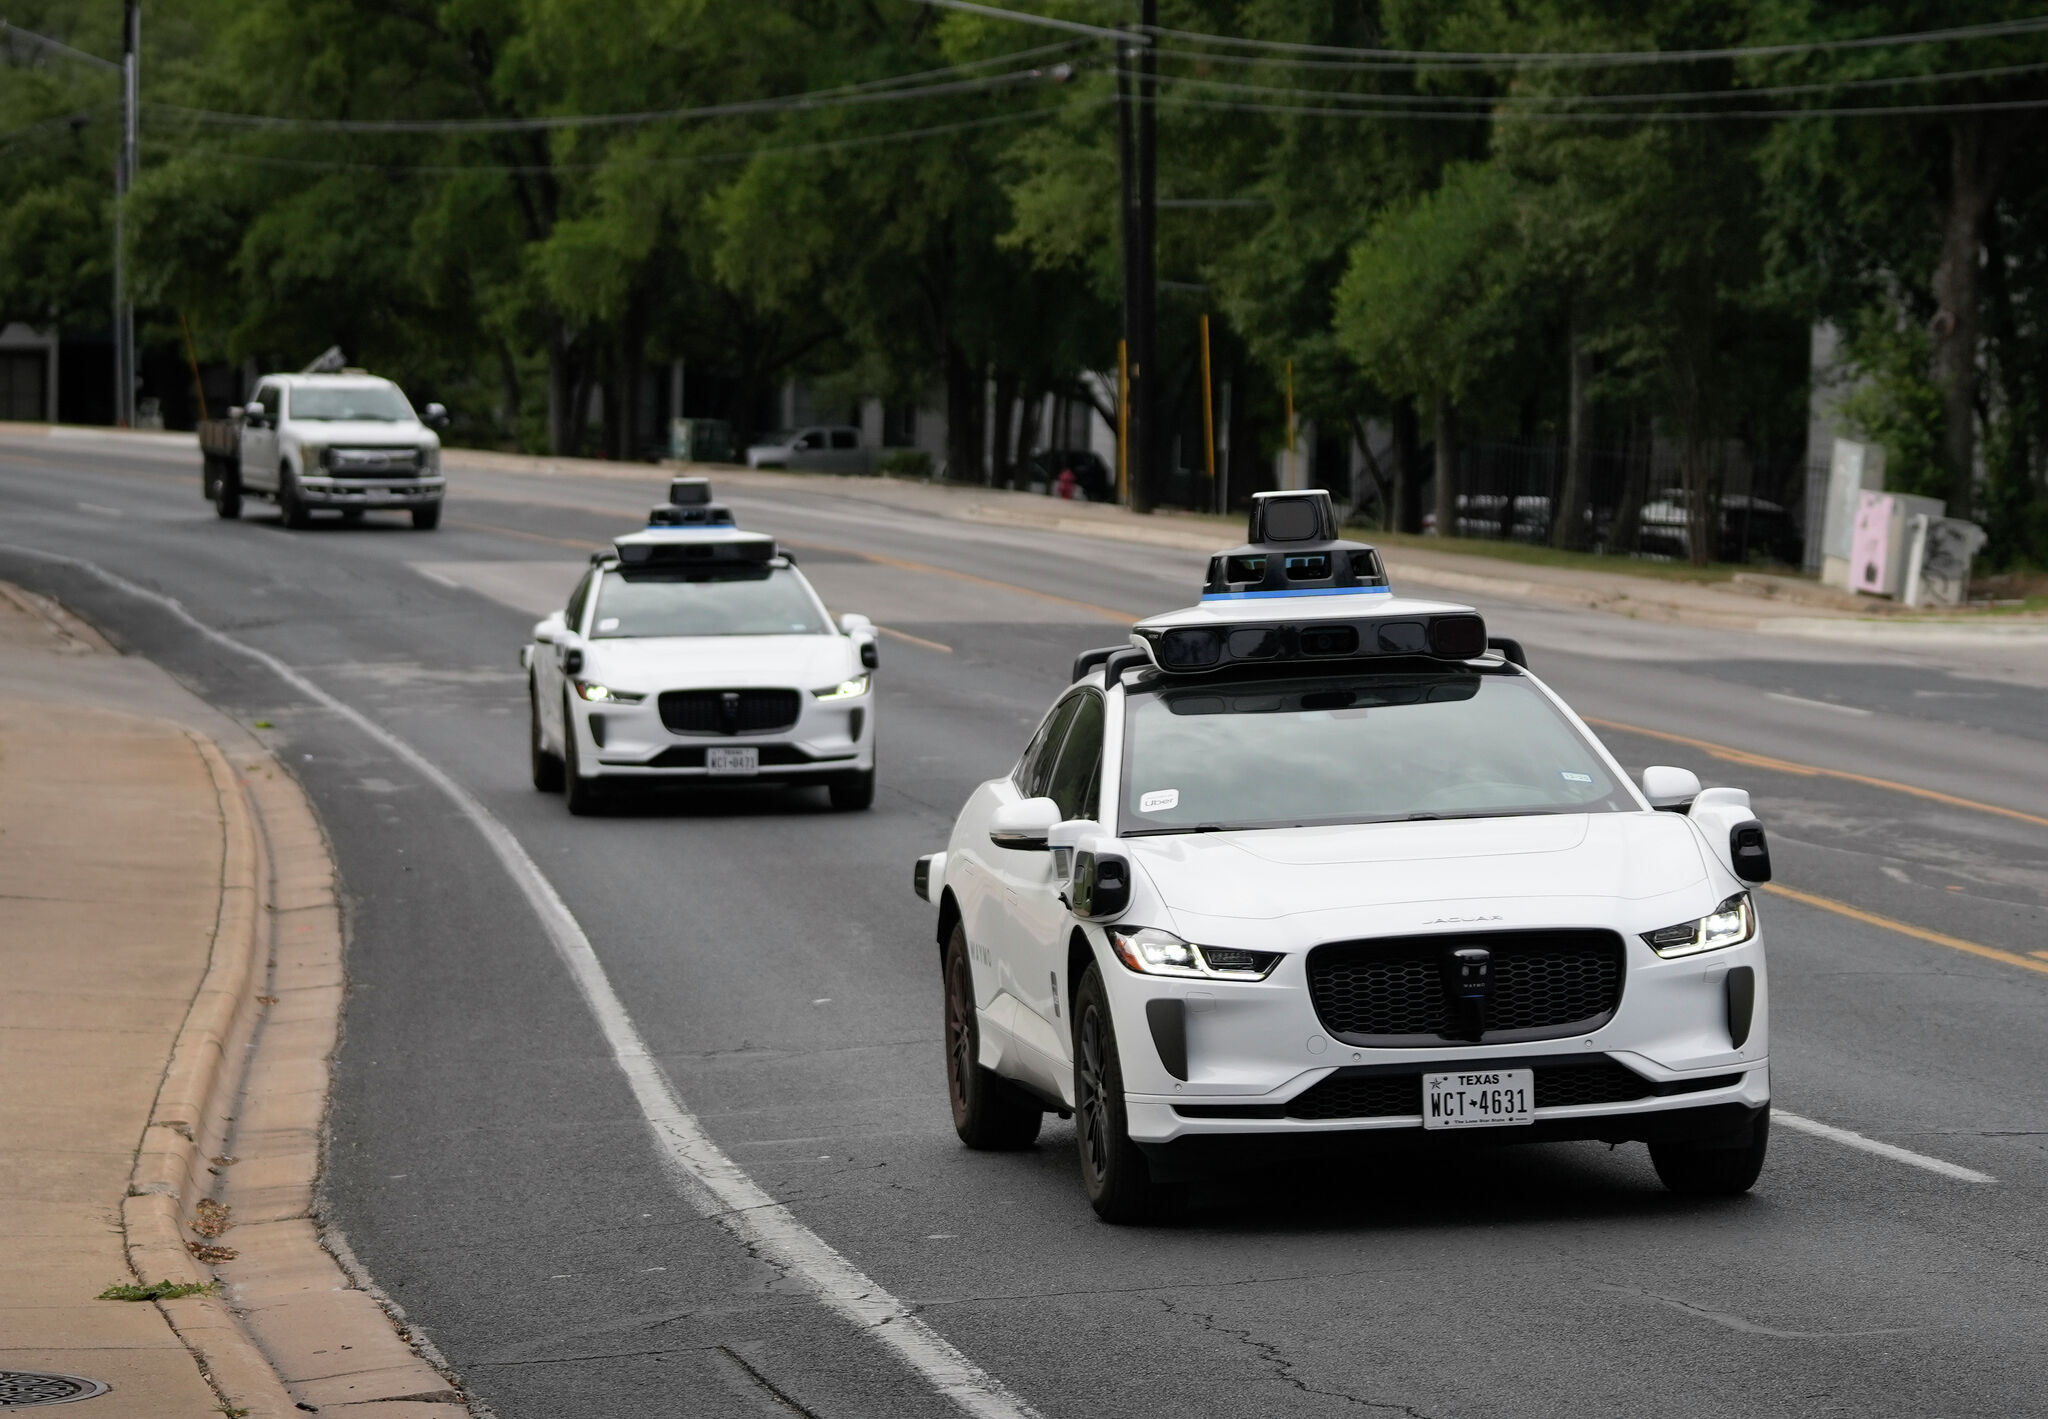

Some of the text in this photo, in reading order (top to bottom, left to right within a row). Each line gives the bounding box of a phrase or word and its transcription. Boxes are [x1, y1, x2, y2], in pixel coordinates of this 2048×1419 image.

[1458, 1074, 1500, 1086] TEXAS
[1431, 1088, 1528, 1117] WCT 4631
